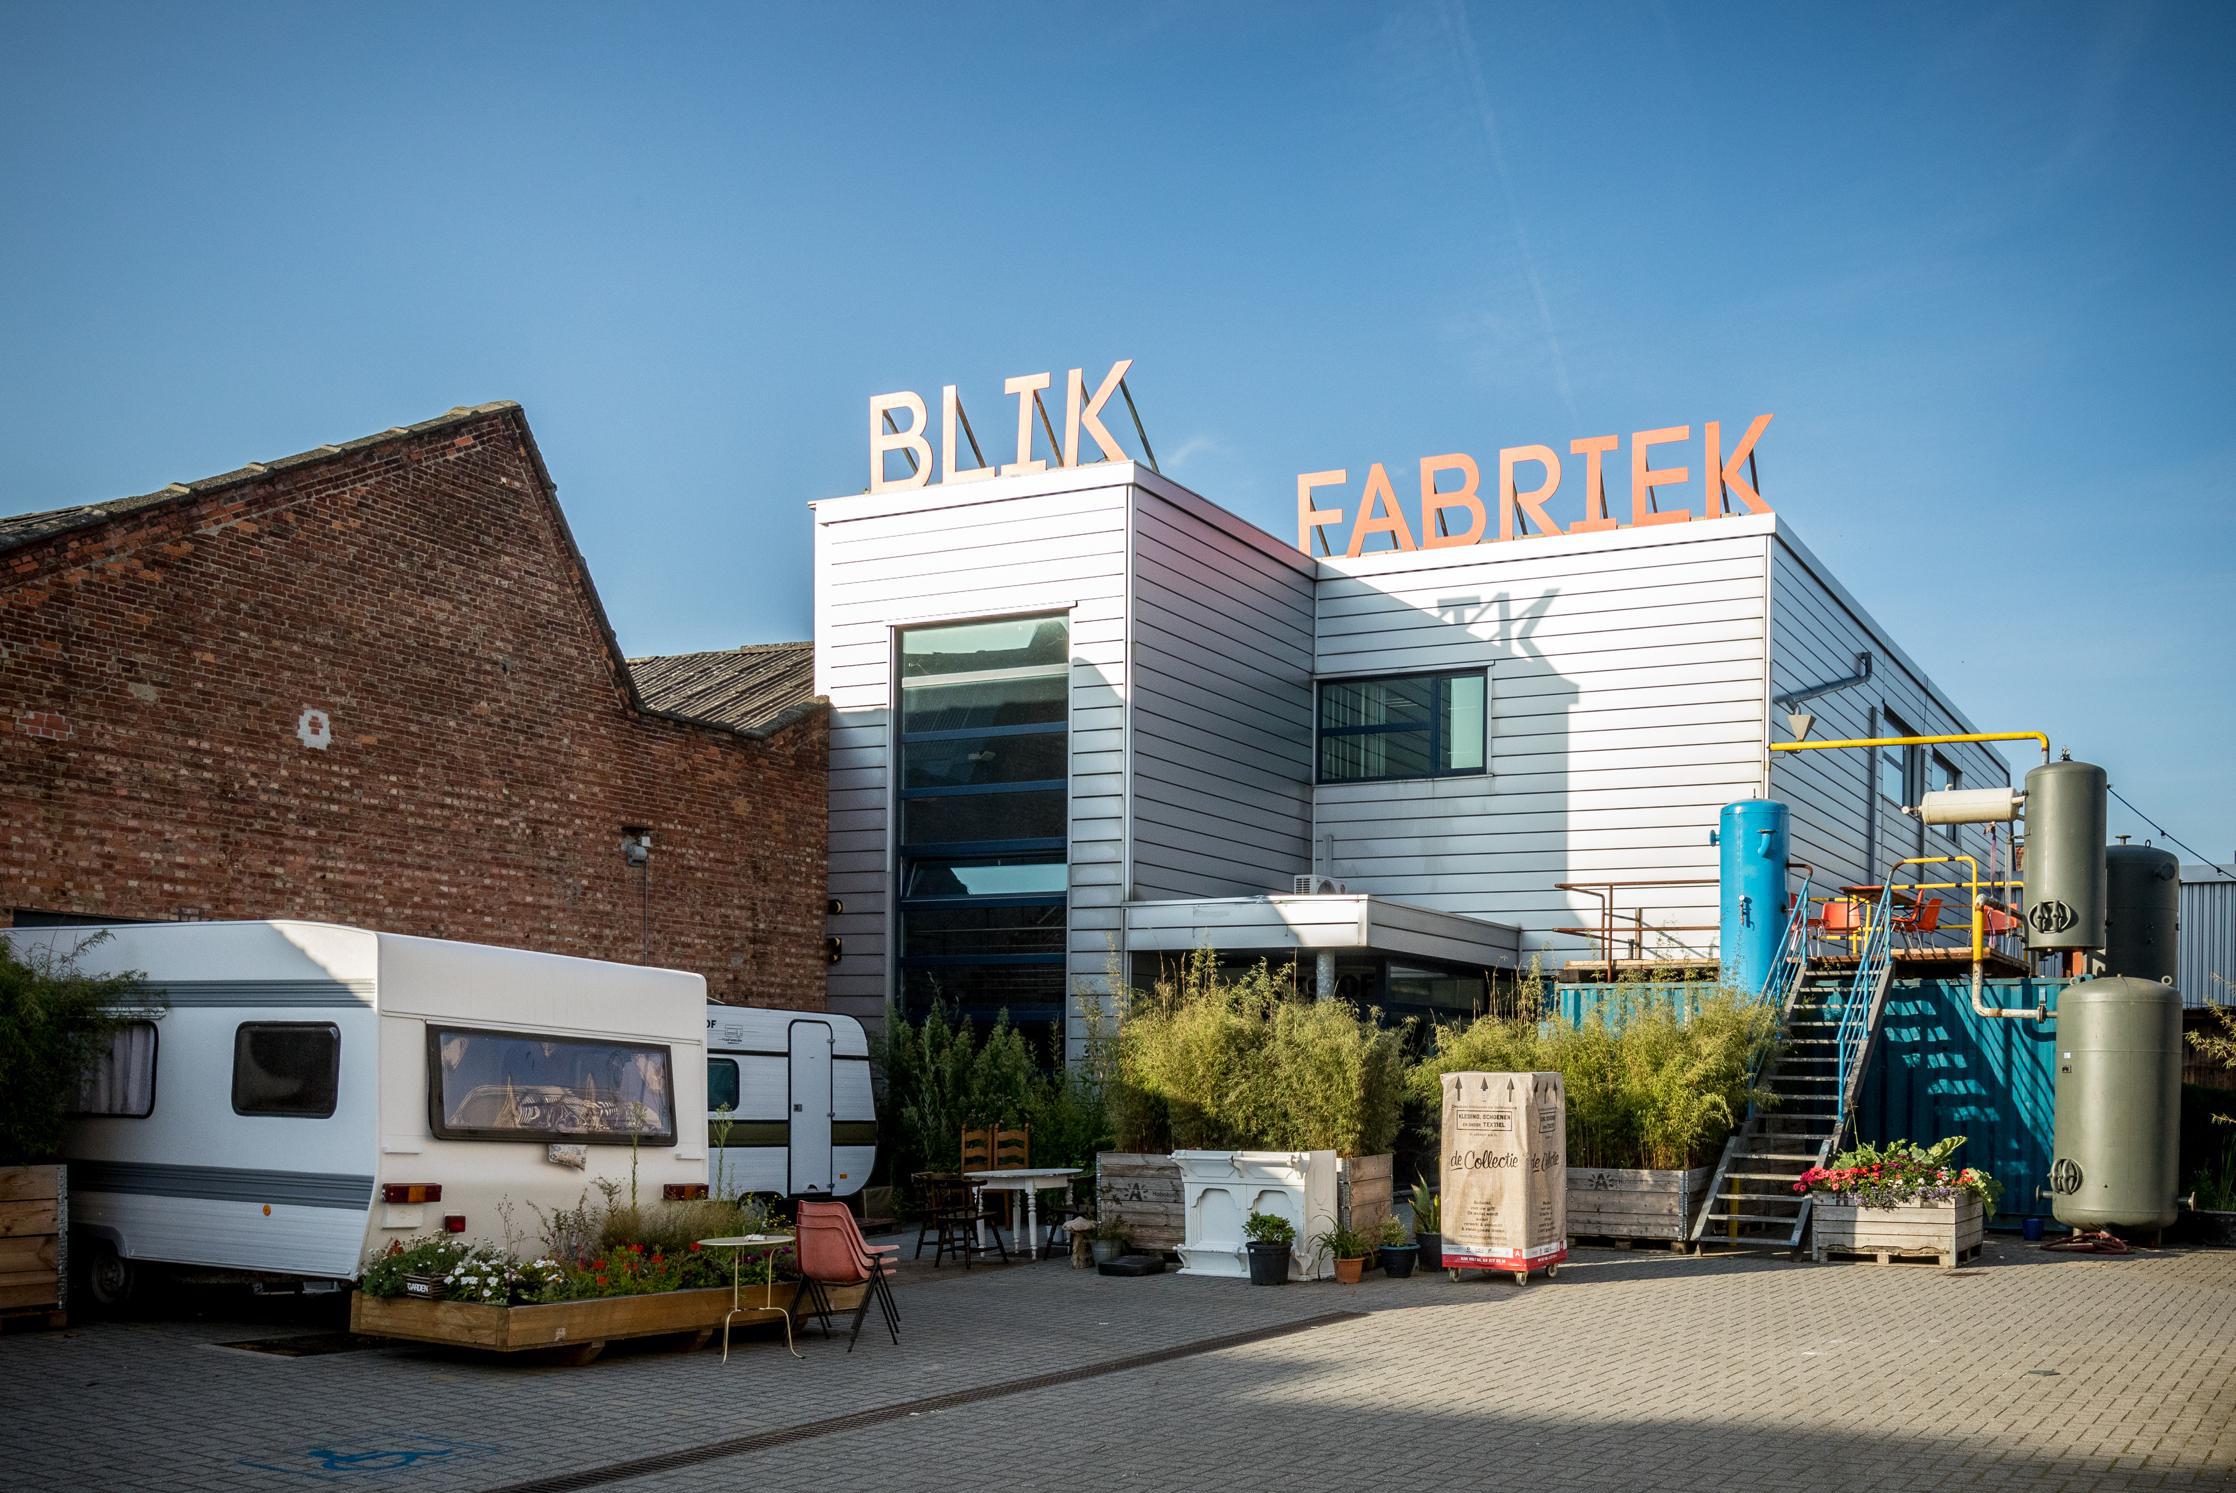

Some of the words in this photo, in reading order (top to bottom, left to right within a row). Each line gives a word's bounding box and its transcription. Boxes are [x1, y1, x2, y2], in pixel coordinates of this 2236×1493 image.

[869, 359, 1130, 494] BLIK
[1297, 413, 1776, 558] FABRIEK
[1450, 1151, 1463, 1171] de
[1464, 1150, 1519, 1170] Collectie
[407, 1282, 429, 1293] GARDEN
